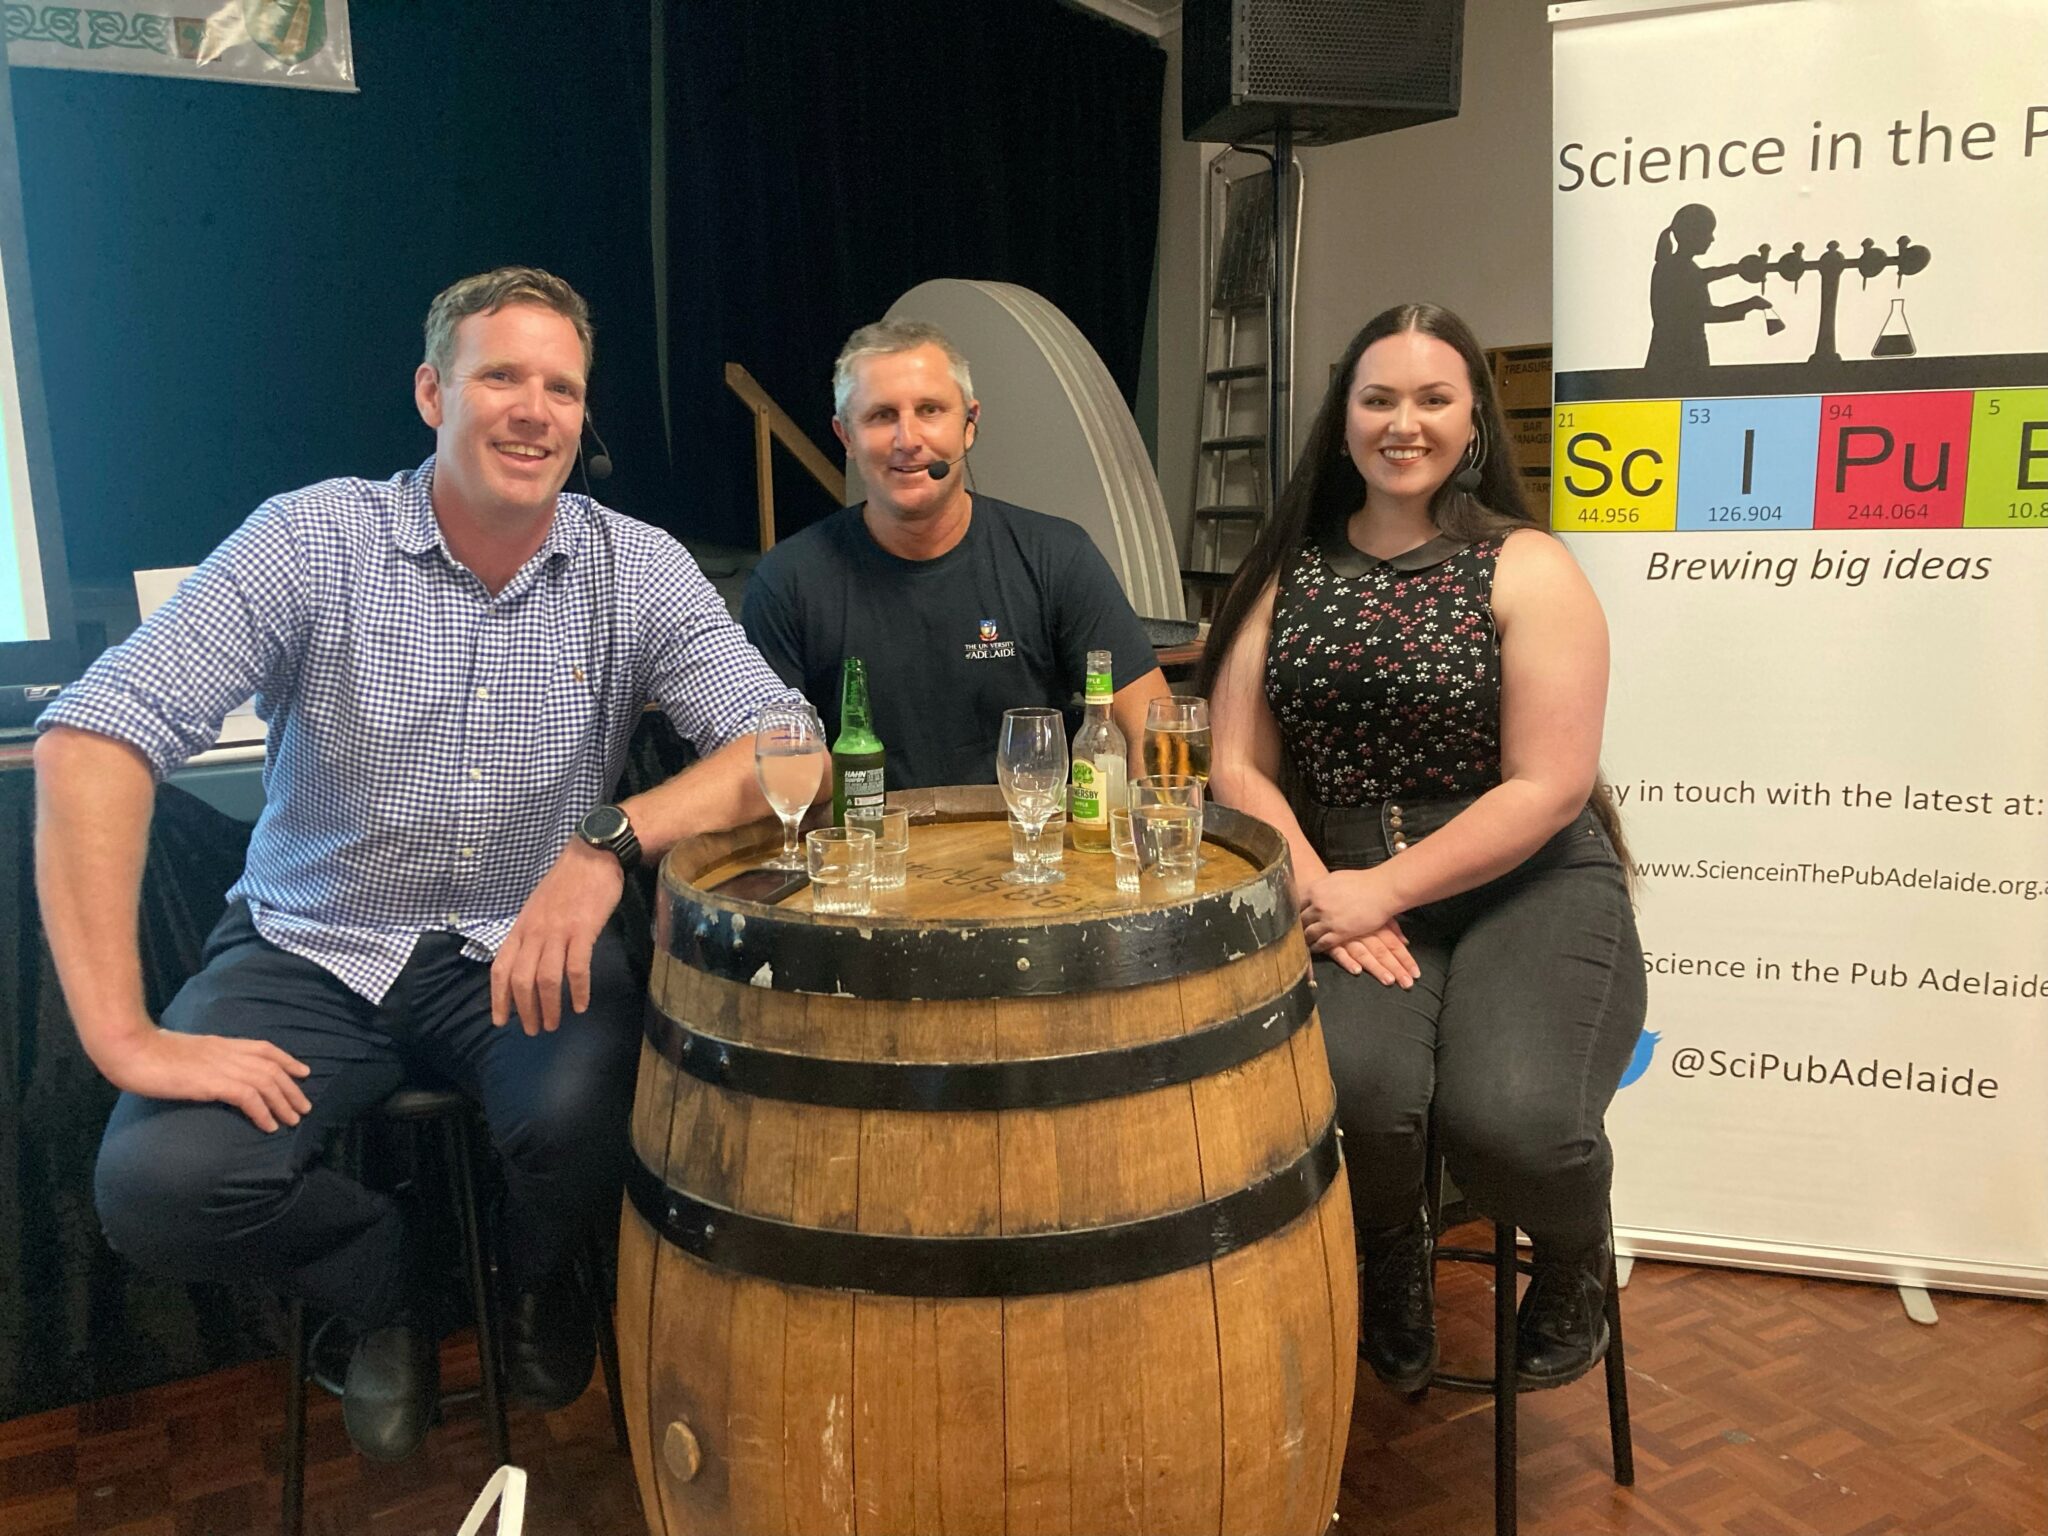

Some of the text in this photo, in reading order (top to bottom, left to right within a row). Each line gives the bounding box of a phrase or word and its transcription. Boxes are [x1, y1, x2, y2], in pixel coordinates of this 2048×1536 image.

[1558, 136, 1786, 192] Science
[1811, 120, 1862, 172] in
[1888, 110, 1996, 167] the
[1829, 404, 1853, 420] 94
[1988, 399, 2001, 415] 5
[1558, 412, 1575, 428] 21
[1688, 408, 1711, 424] 53
[1563, 432, 1663, 498] Sc
[1741, 429, 1755, 495] I
[1835, 426, 1950, 493] Pu
[1577, 507, 1640, 523] 44.956
[1708, 505, 1782, 522] 126.904
[1847, 503, 1929, 520] 244.064
[1646, 547, 1993, 588] Brewing big ideas
[978, 641, 1015, 650] UNVERSITY
[845, 770, 867, 778] HAHN
[1640, 780, 1664, 802] in
[1673, 780, 1755, 804] touch
[1766, 782, 1831, 807] with
[1841, 784, 1893, 809] the
[1904, 785, 1994, 815] latest
[2003, 794, 2044, 816] at:
[1756, 957, 1781, 981] in
[1791, 958, 1840, 984] the
[1851, 962, 1908, 988] Pub
[1671, 1047, 1999, 1099] @SciPubAdelaide
